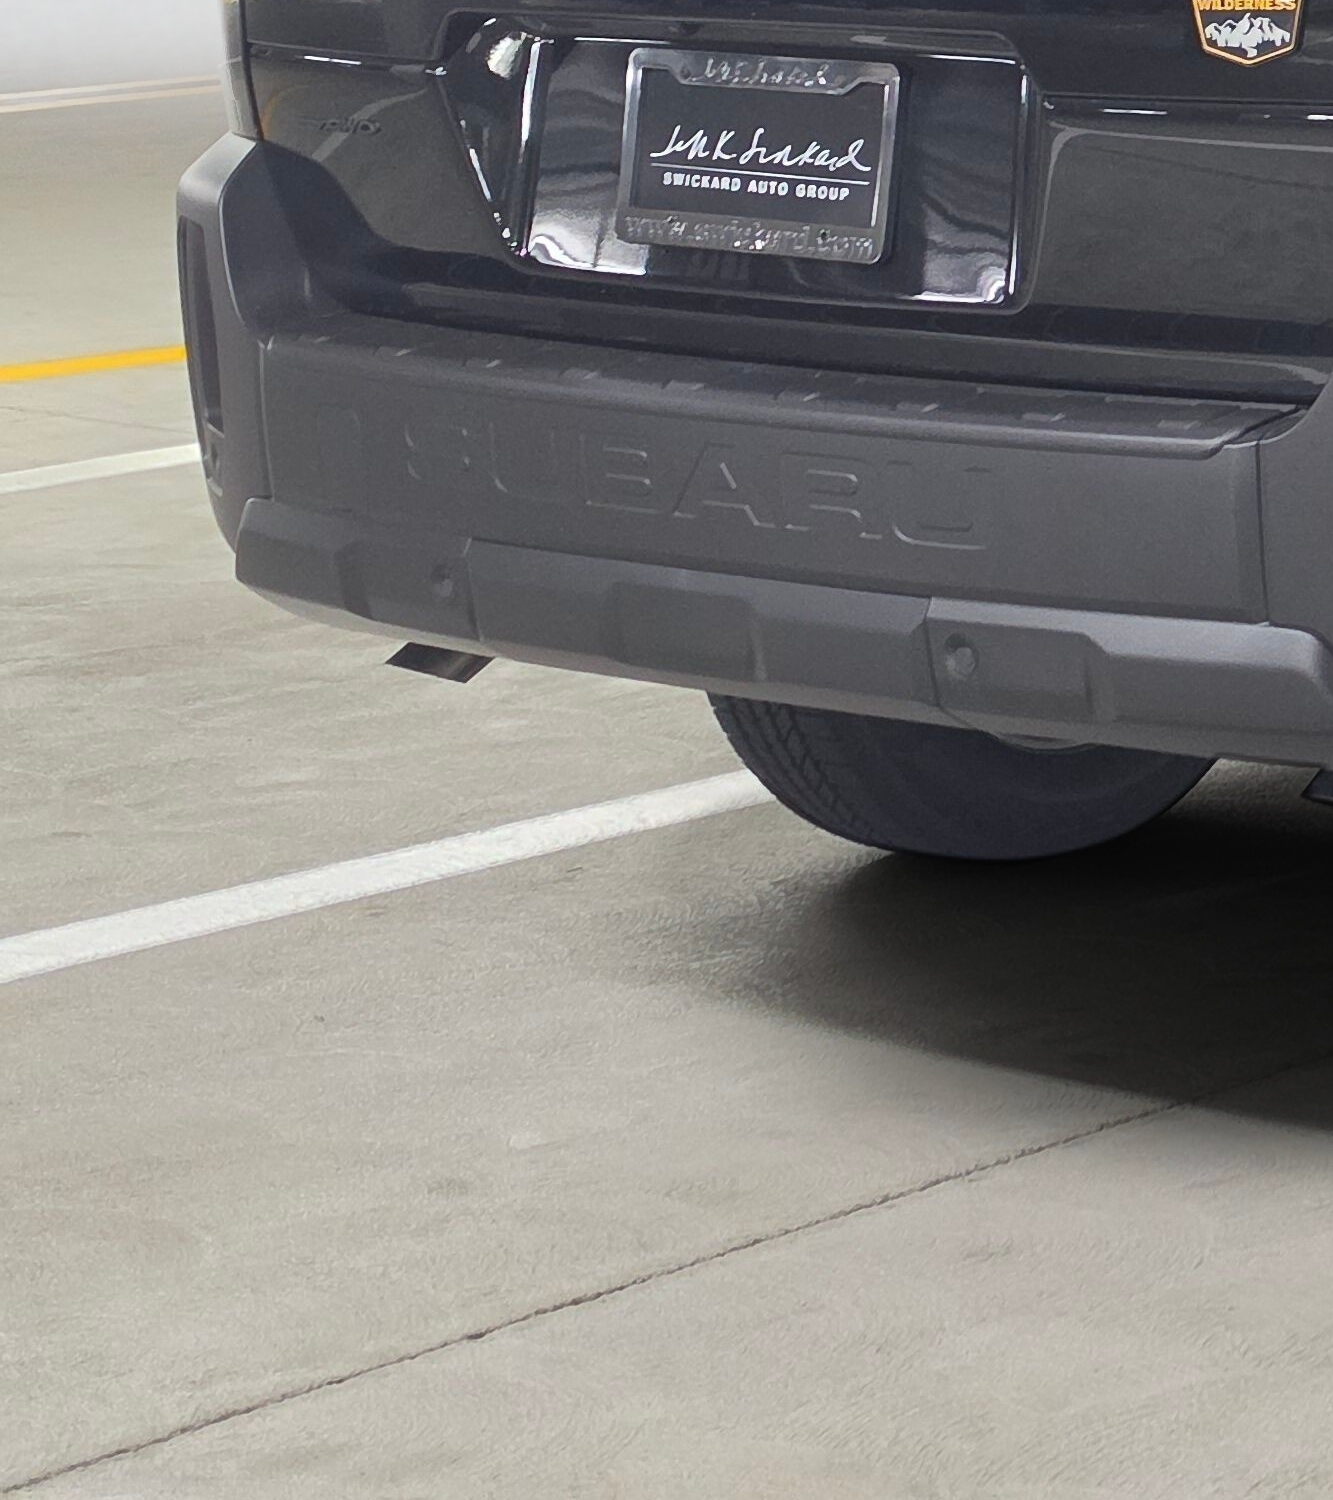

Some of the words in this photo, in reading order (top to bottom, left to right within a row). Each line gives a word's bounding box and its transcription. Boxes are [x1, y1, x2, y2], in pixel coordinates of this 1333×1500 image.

[662, 171, 742, 192] SWICKARD
[747, 179, 789, 197] AUTO
[795, 184, 850, 201] GROUP
[403, 418, 992, 551] SUBARU
